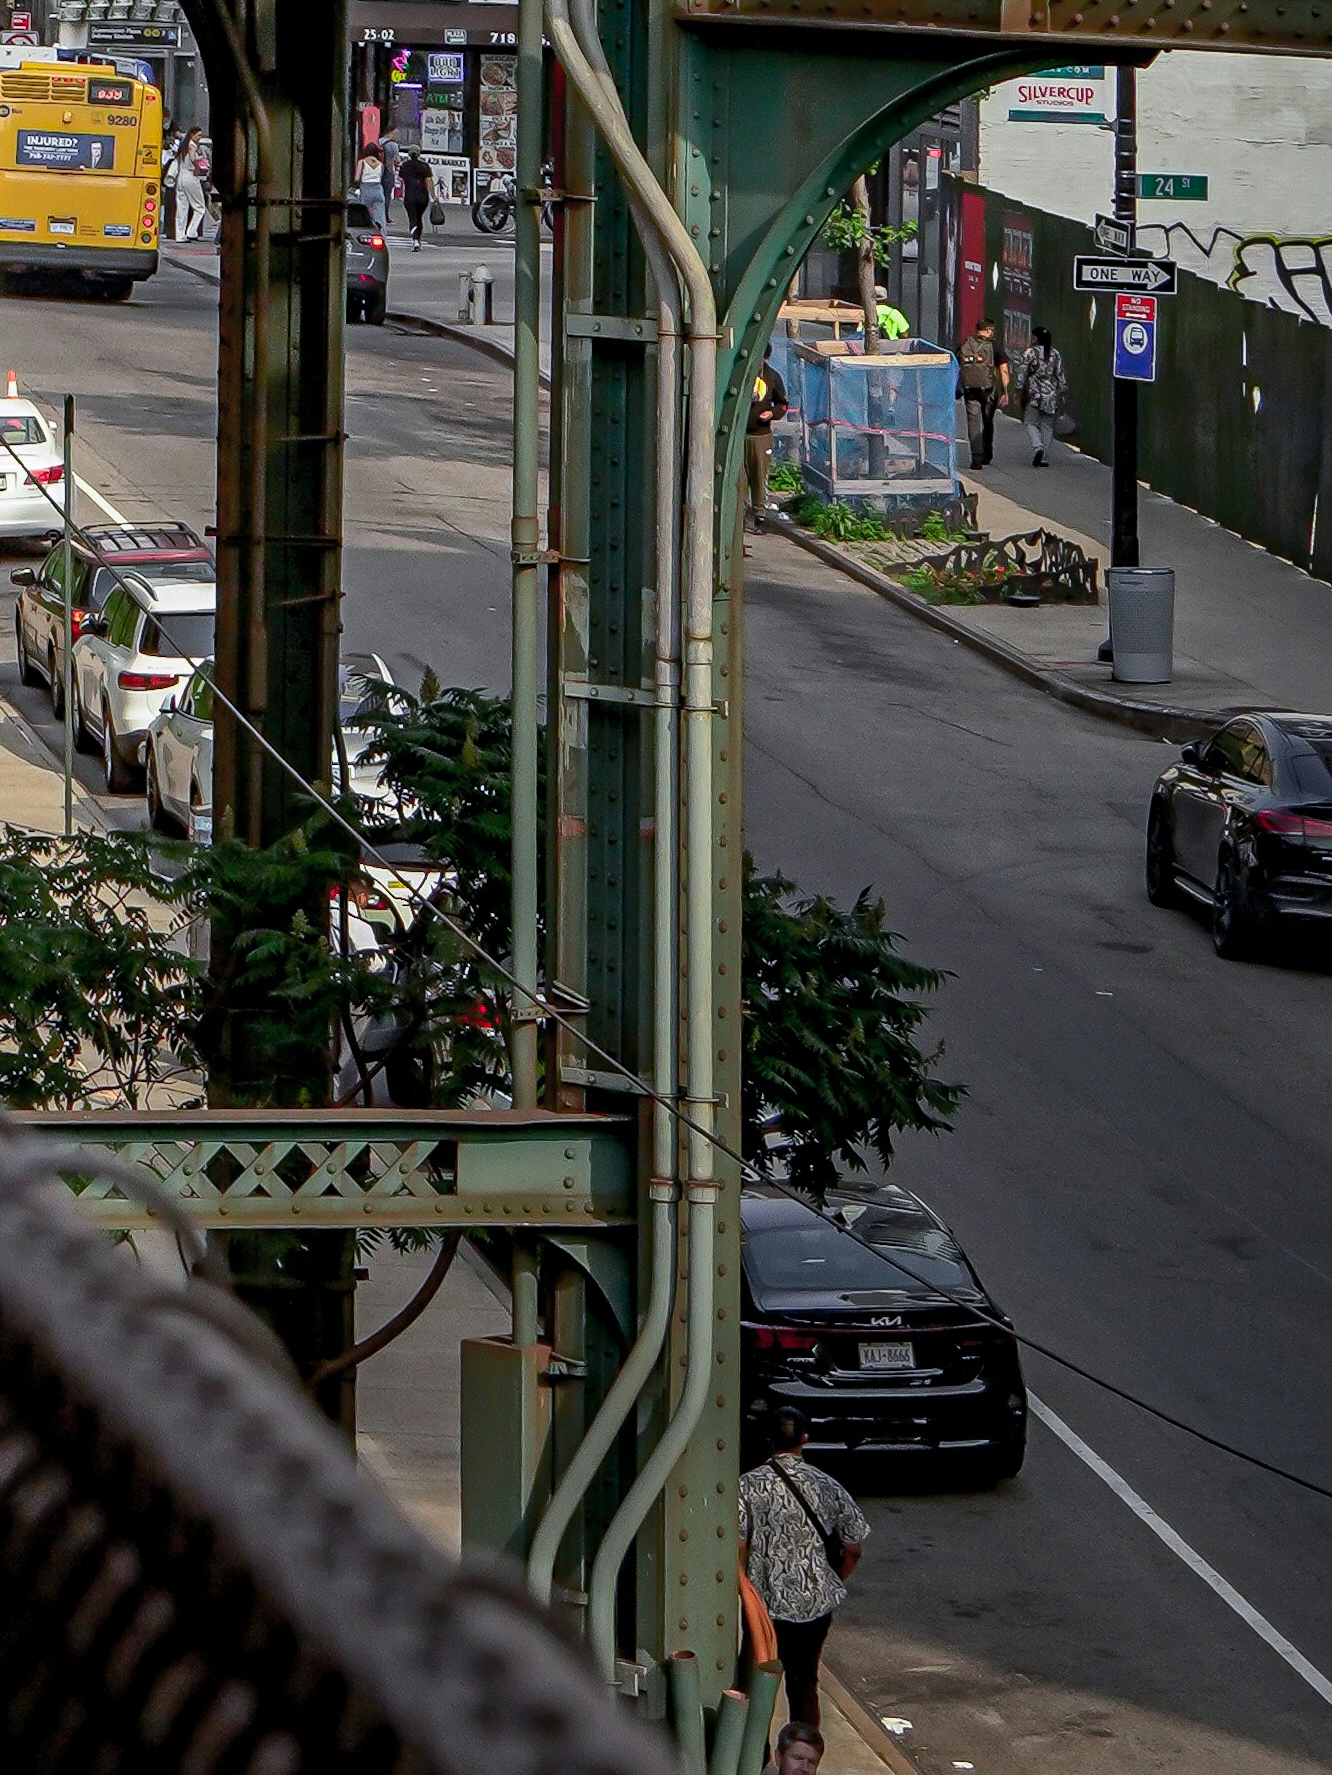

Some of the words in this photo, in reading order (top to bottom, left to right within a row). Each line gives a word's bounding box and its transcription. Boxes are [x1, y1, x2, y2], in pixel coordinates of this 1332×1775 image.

[490, 32, 516, 45] 718
[1018, 85, 1095, 105] SILVERCUP
[107, 114, 138, 127] 9280
[27, 135, 79, 148] INJURED?
[1155, 177, 1174, 196] 24
[1181, 177, 1191, 188] St
[1090, 268, 1119, 281] ONE
[1131, 268, 1161, 284] WAY
